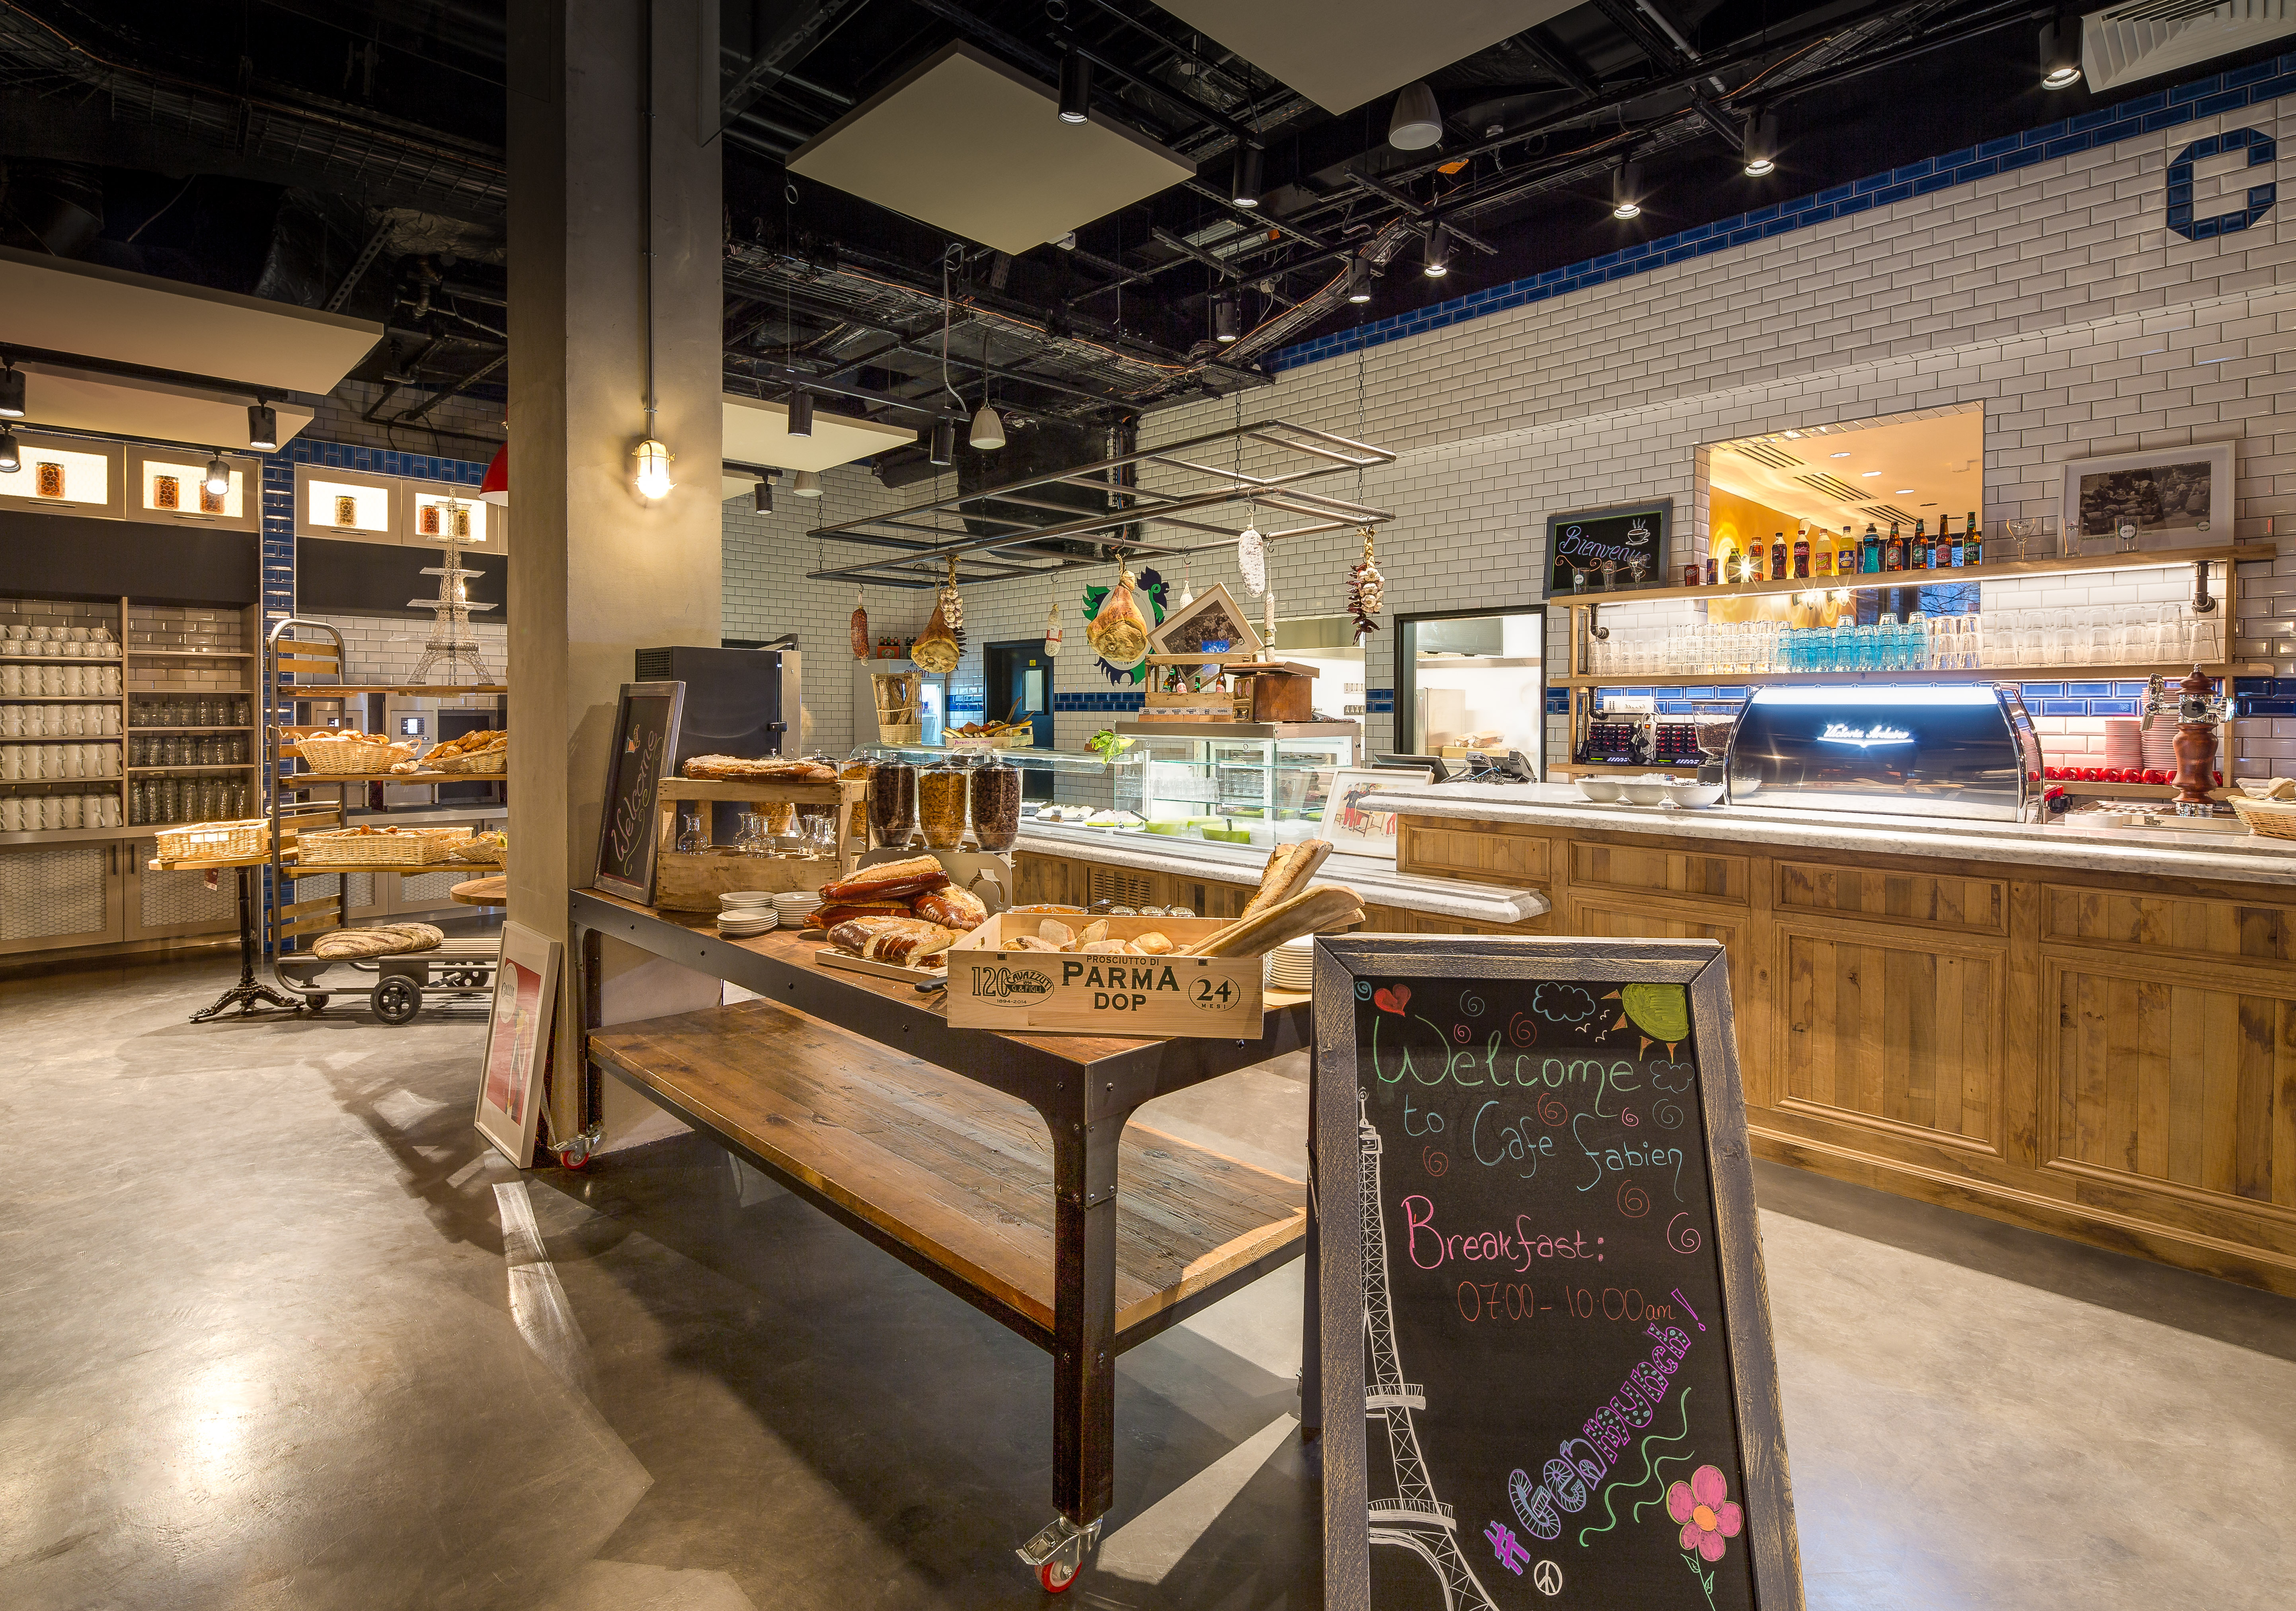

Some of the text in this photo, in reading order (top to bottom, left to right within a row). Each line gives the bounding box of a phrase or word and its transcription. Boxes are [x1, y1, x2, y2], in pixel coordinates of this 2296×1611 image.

[1824, 724, 1910, 739] Victoria Arduino
[612, 731, 657, 861] Welcome
[1087, 955, 1159, 966] PROSCIUTTO DI
[1007, 971, 1052, 992] CAVAZZUTI
[1062, 961, 1180, 991] PARMA
[1094, 992, 1146, 1012] DOP
[1196, 978, 1232, 1003] 24
[1374, 1015, 1641, 1117] Welcome
[1405, 1094, 1444, 1136] to
[1473, 1101, 1556, 1178] Cafe
[1401, 1195, 1603, 1272] Breakfast:
